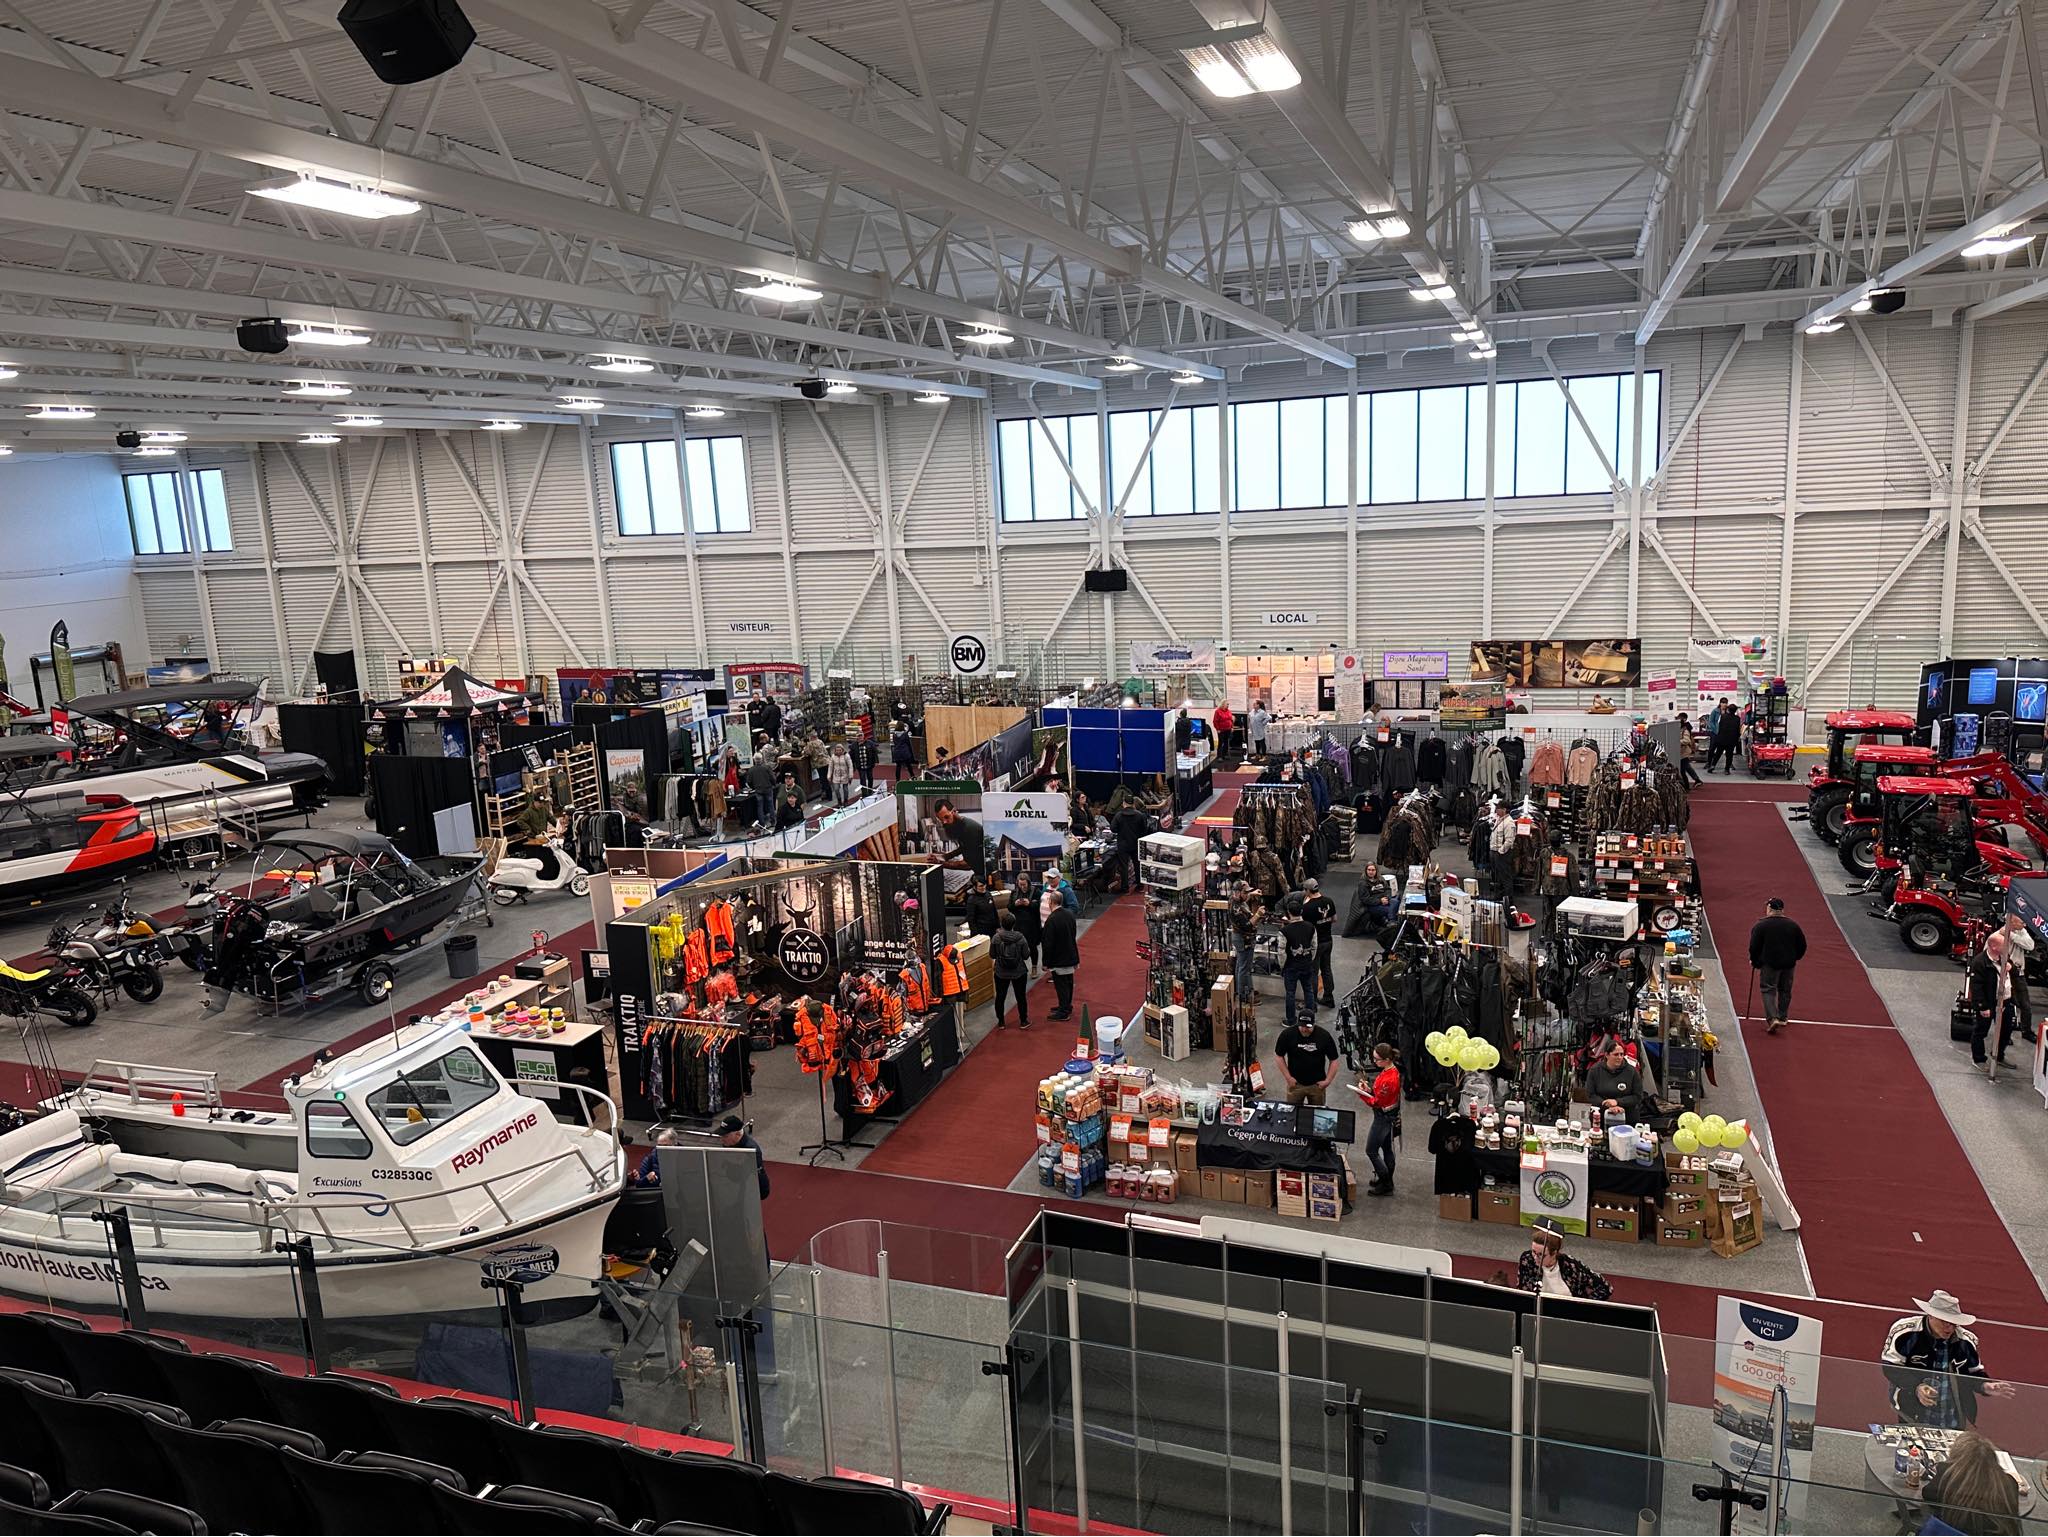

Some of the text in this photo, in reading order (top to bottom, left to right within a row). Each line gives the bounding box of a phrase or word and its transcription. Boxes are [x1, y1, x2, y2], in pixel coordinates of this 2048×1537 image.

[1270, 614, 1308, 623] LOCAL
[730, 623, 770, 632] VISITEUR
[1692, 638, 1741, 646] Tupperware
[954, 647, 981, 661] BM
[164, 767, 203, 777] MANITOU
[885, 940, 896, 948] de
[323, 946, 367, 963] TROLLER
[785, 950, 822, 965] TRAKTIQ
[864, 950, 886, 958] viens
[620, 994, 639, 1053] TRAKTIQ
[517, 1061, 555, 1075] FLAT
[1227, 1128, 1255, 1140] Cégep
[1256, 1131, 1268, 1140] de
[451, 1112, 538, 1174] Raymarine
[371, 1169, 433, 1181] C32853QC
[312, 1177, 362, 1188] Excursions
[1752, 1317, 1784, 1330] EN VENTE
[1760, 1326, 1775, 1338] ICI
